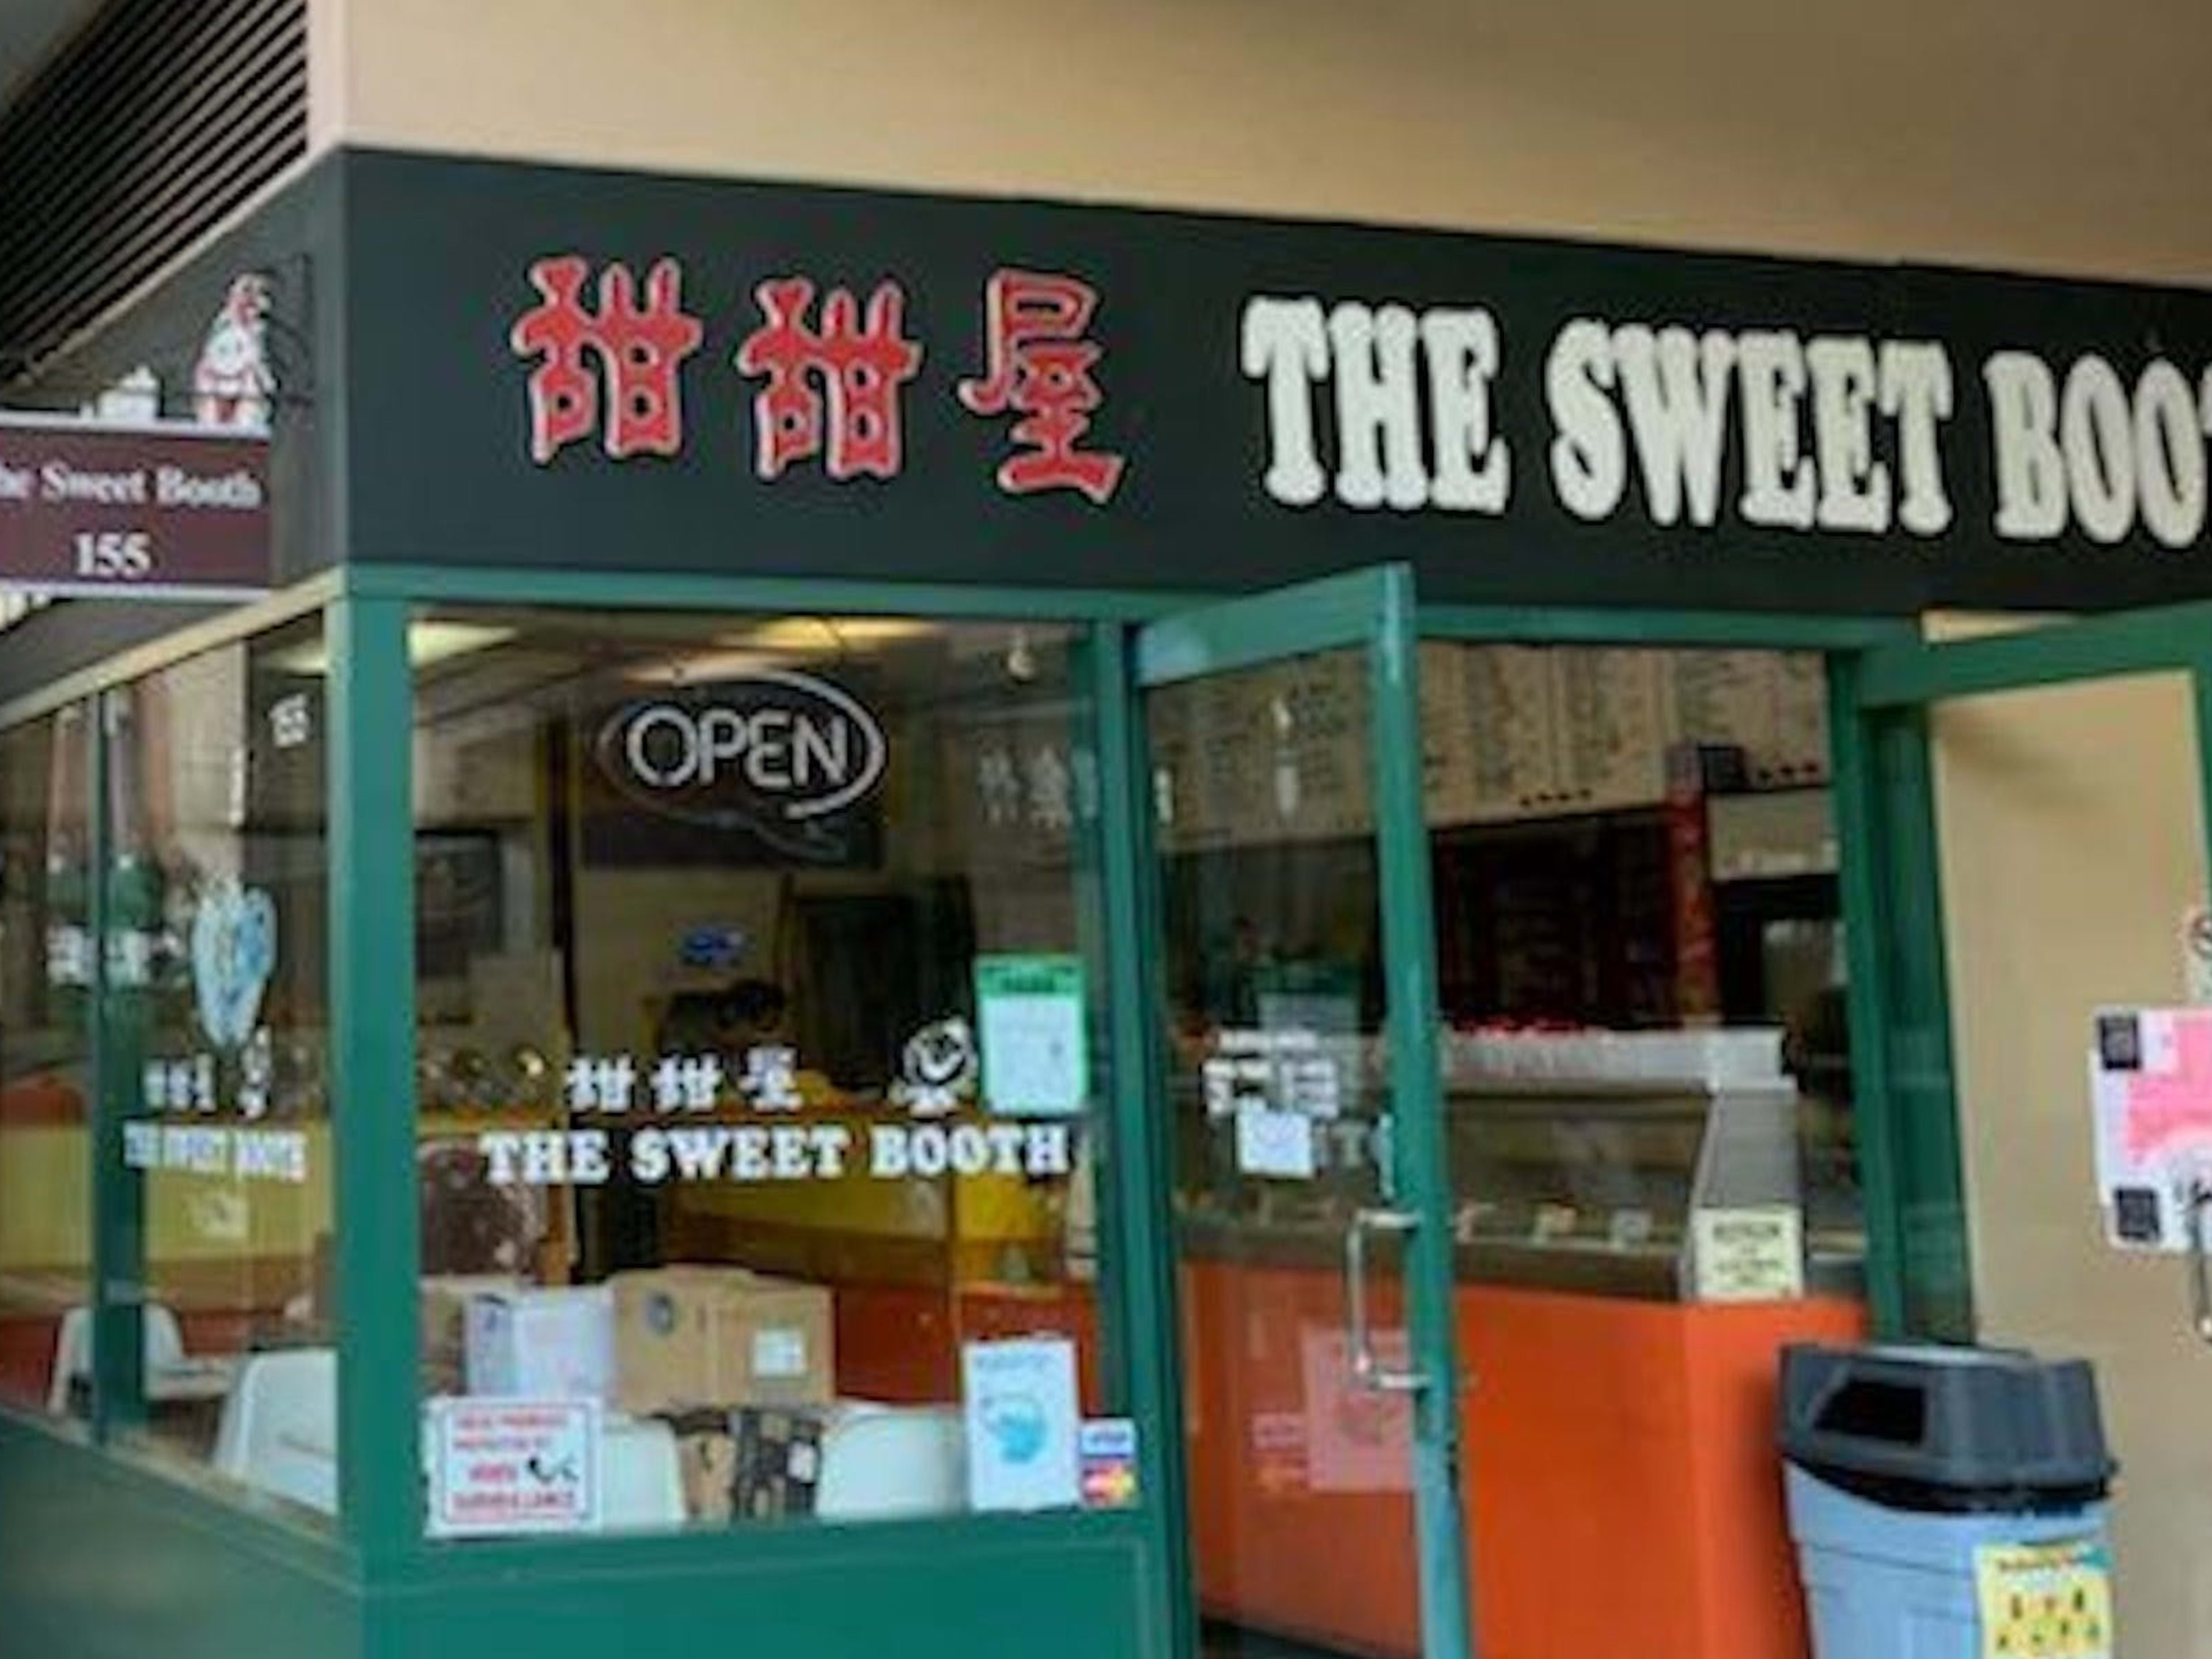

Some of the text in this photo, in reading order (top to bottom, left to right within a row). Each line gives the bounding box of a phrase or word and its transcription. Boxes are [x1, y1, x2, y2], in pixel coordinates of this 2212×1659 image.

[510, 255, 1127, 503] 甜甜屋
[1240, 295, 2212, 548] THE SWEET BOO
[0, 459, 263, 508] he Sweet Booth
[74, 531, 152, 578] 155
[626, 706, 849, 789] OPEN
[476, 1122, 1071, 1188] THE SWEET BOOTH
